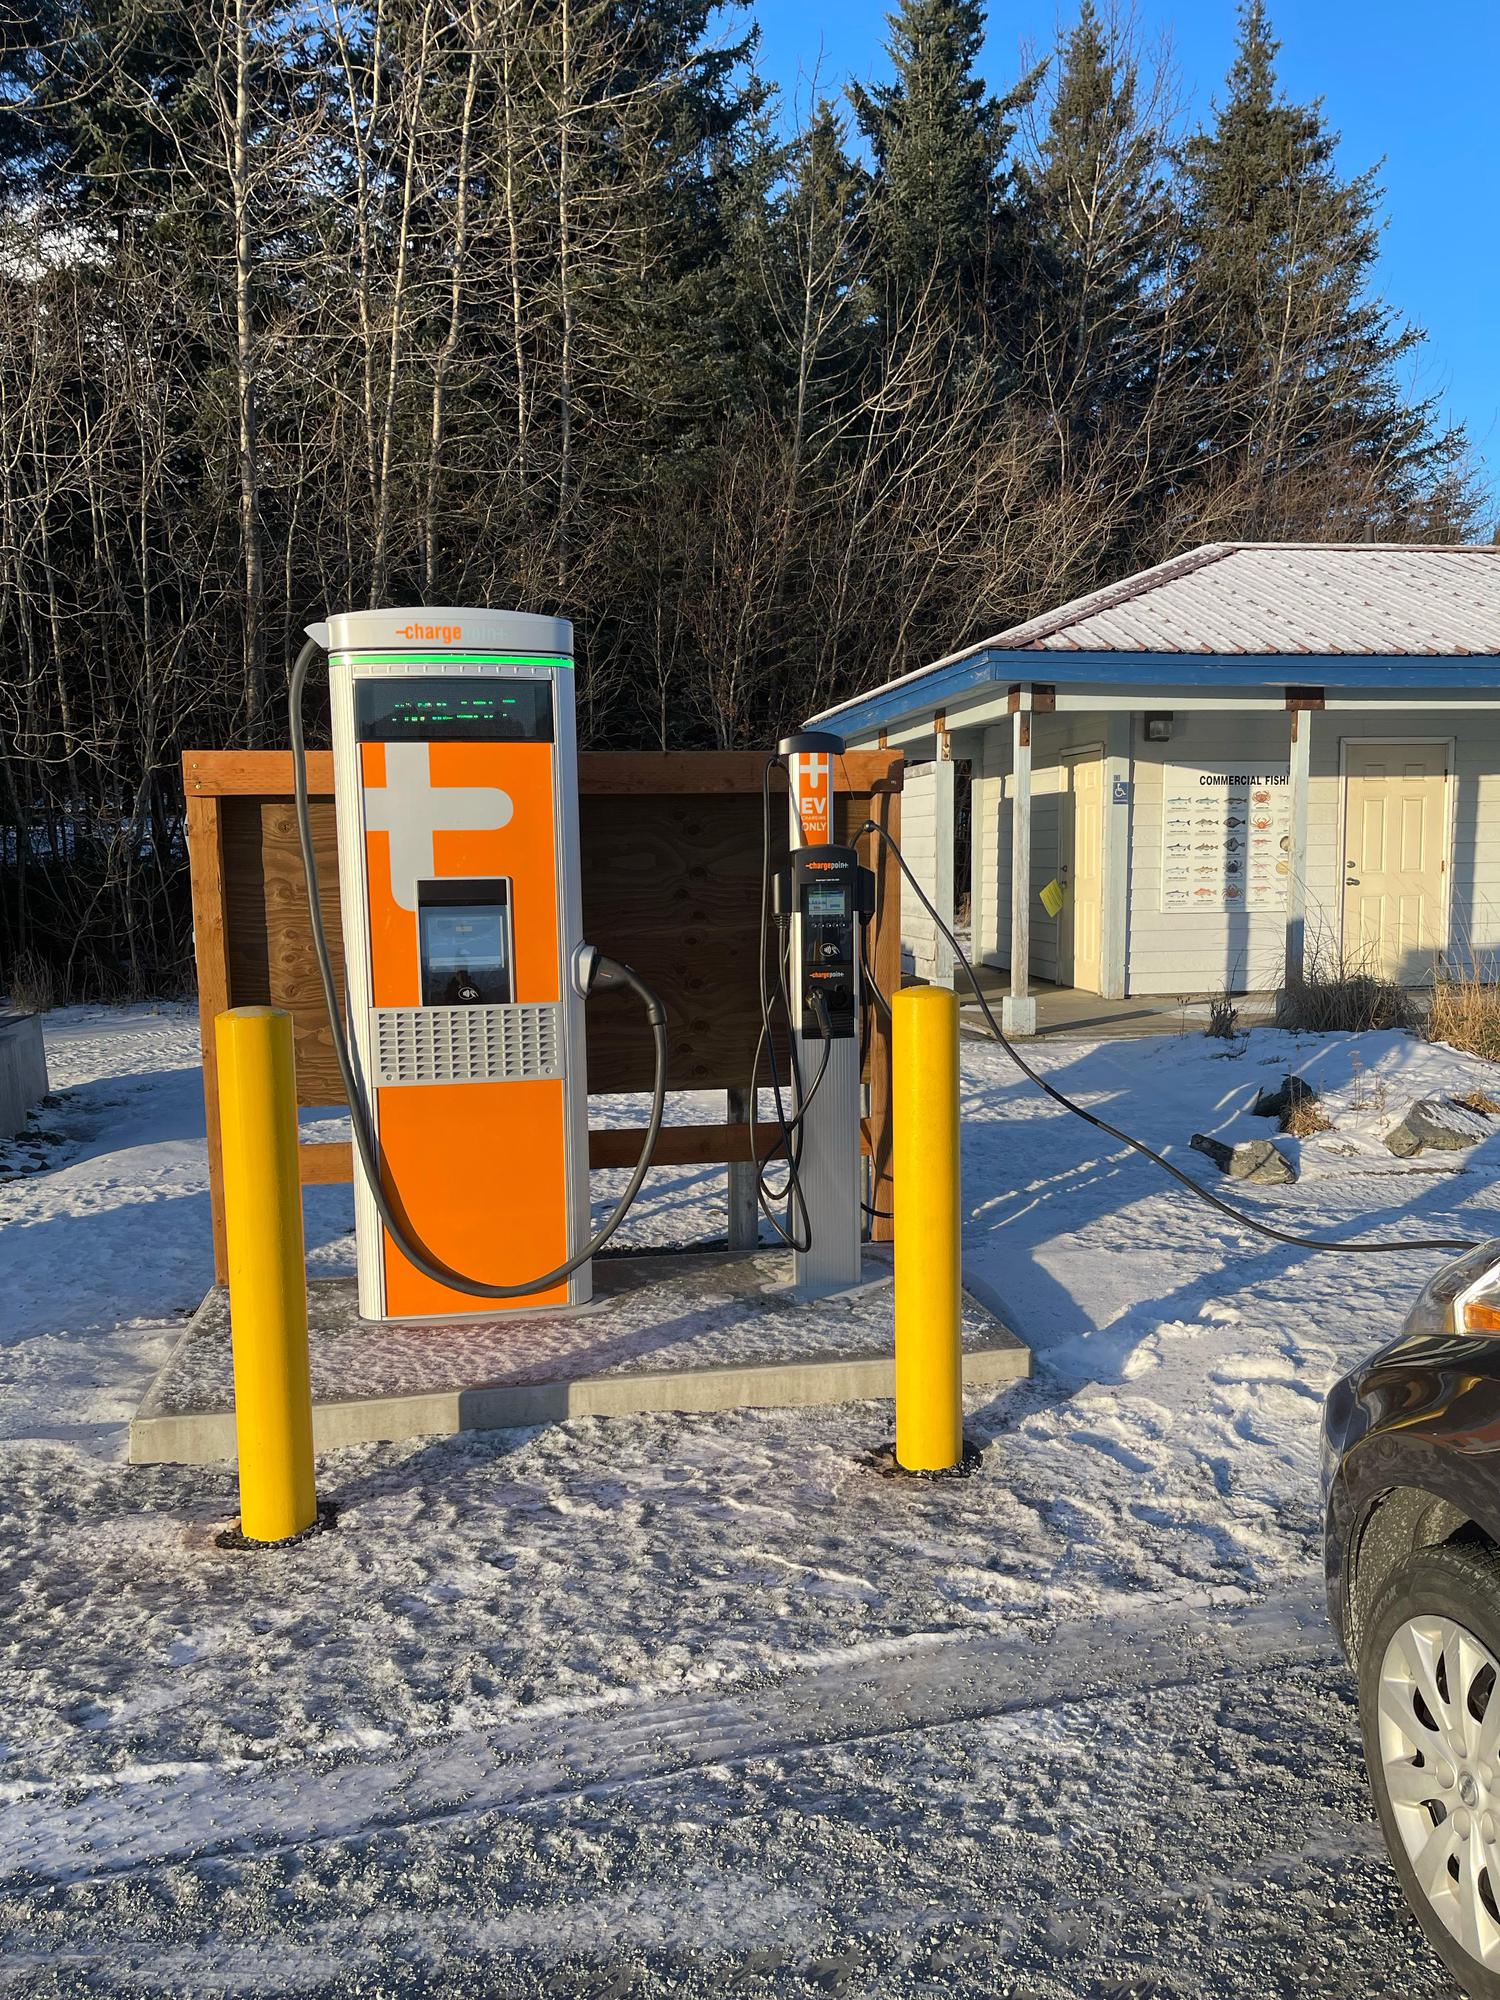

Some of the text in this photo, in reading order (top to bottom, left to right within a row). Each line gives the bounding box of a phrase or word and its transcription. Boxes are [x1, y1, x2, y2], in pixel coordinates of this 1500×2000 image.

[1199, 775, 1262, 786] COMMERCIAL
[801, 797, 826, 814] EV
[801, 822, 826, 832] ONLY
[805, 860, 849, 871] chargepoint
